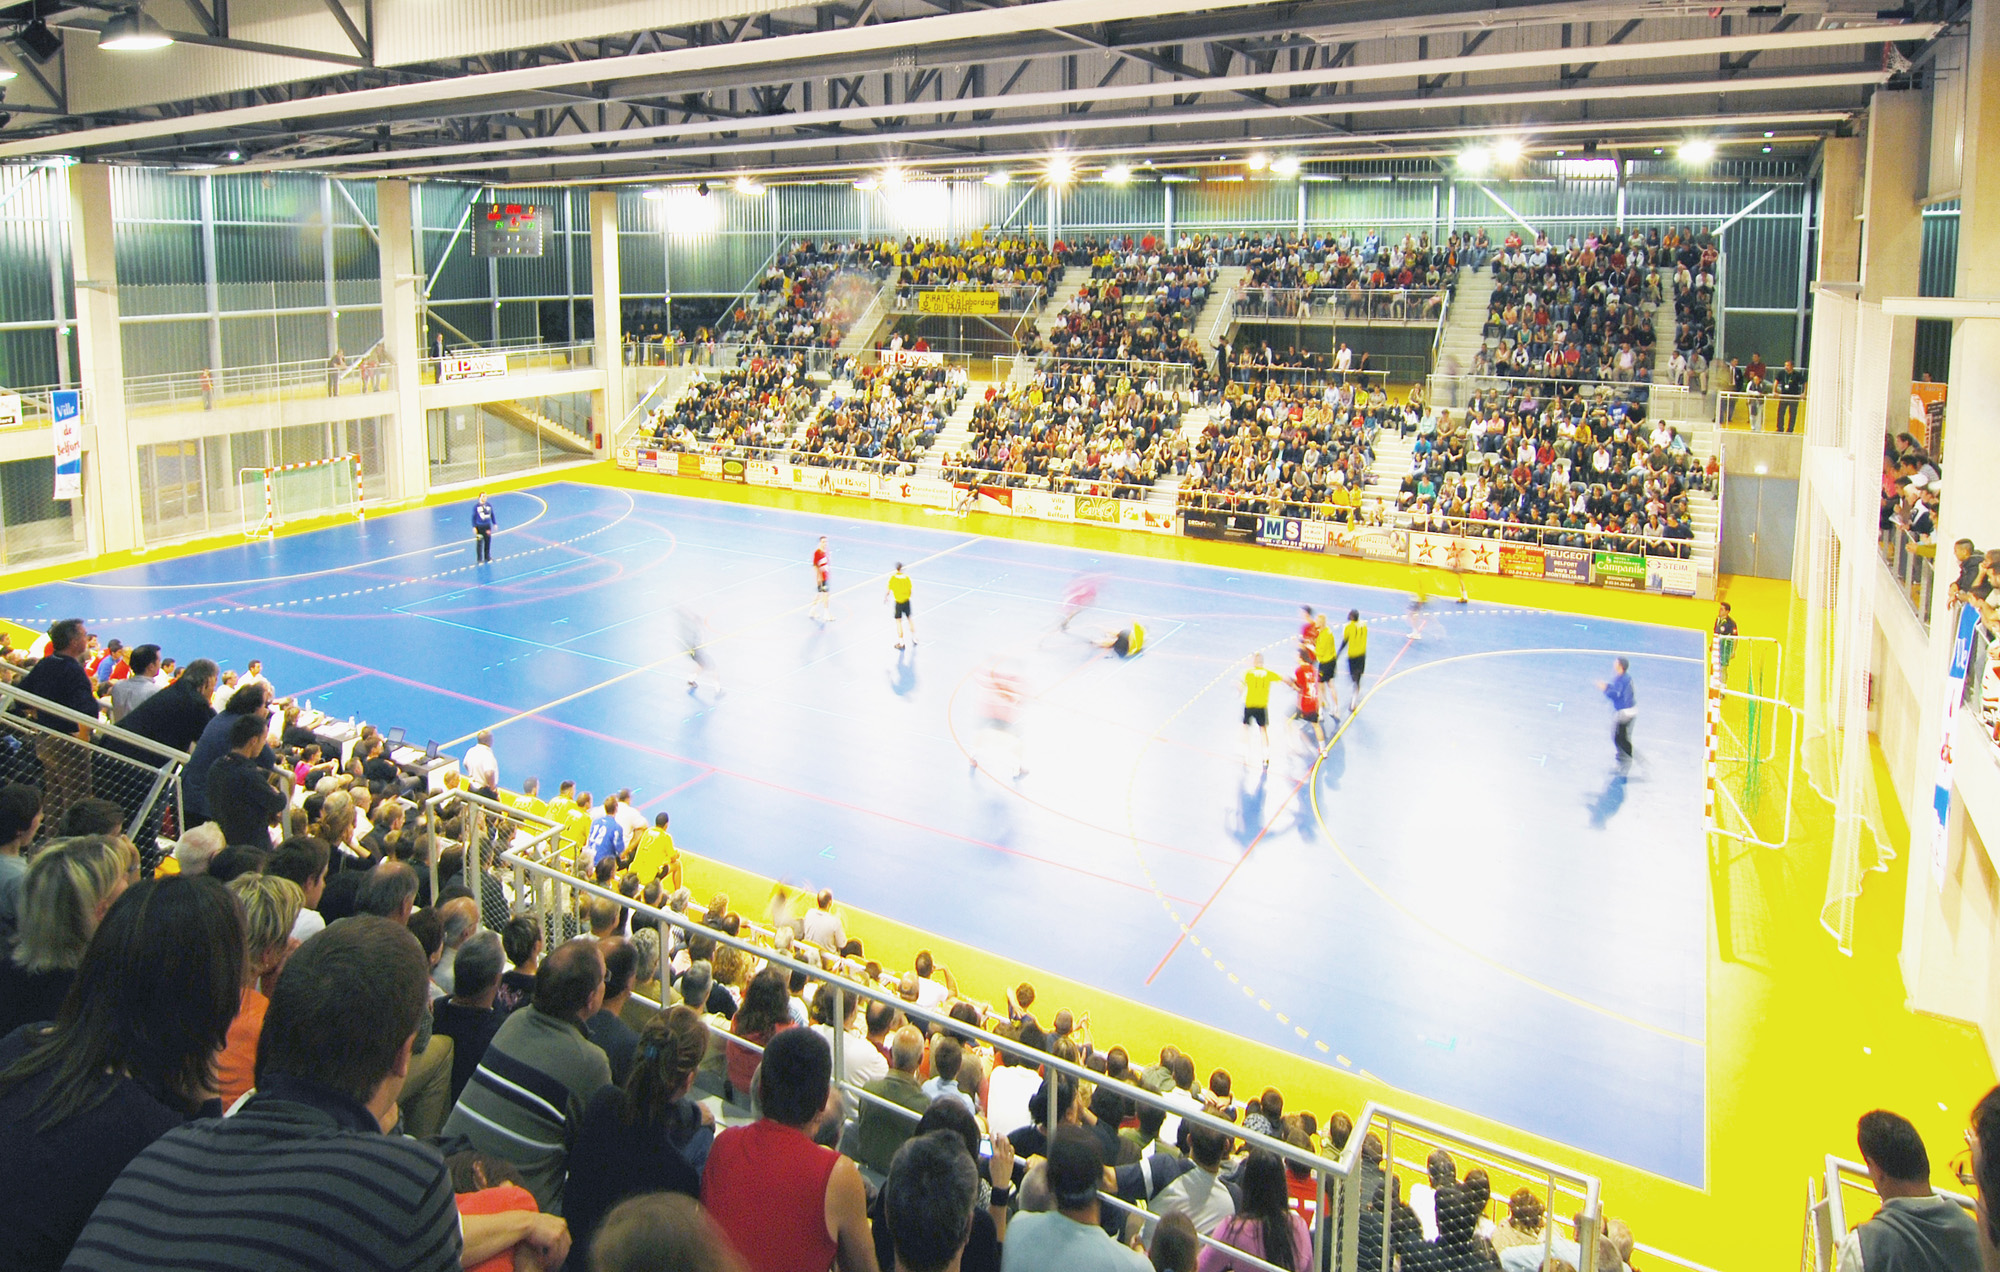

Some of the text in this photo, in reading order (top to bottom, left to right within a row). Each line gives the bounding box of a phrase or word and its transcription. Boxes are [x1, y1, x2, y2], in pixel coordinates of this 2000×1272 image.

[895, 352, 928, 364] PAYS
[56, 402, 75, 416] Ville
[64, 424, 72, 436] de
[56, 440, 80, 456] Belfort
[1544, 549, 1589, 561] PEUGEOT
[1597, 561, 1645, 574] Campanile
